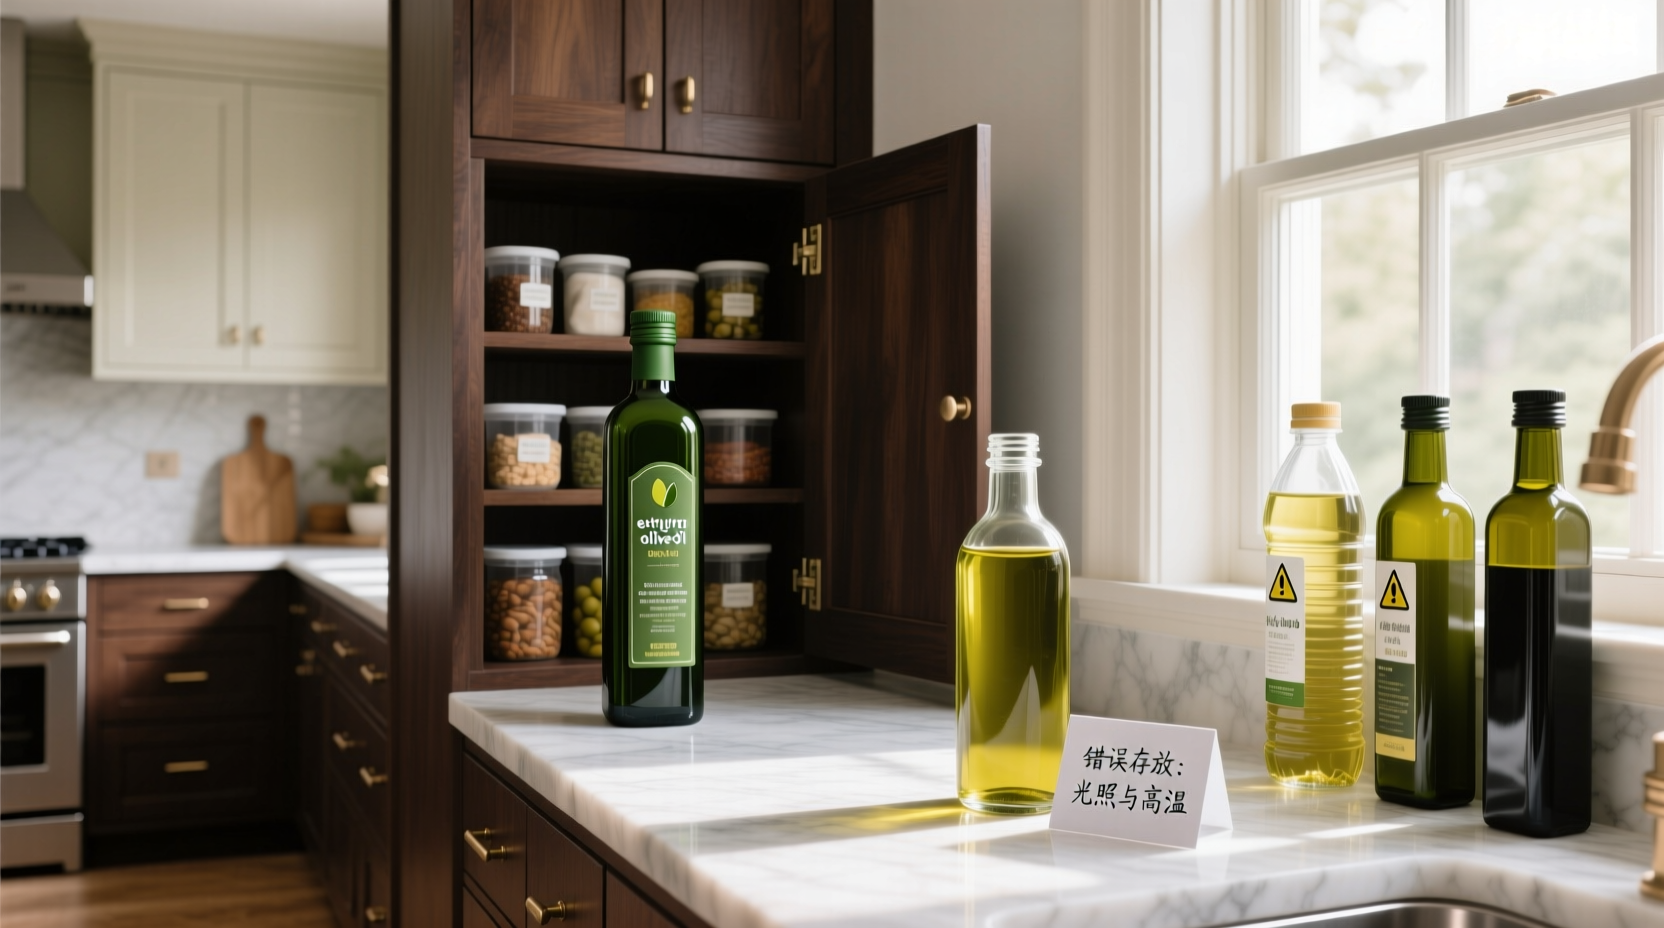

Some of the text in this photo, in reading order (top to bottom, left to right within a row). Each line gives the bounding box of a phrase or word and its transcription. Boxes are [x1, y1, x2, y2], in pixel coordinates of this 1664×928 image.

[1071, 779, 1187, 814] 光照与高温
